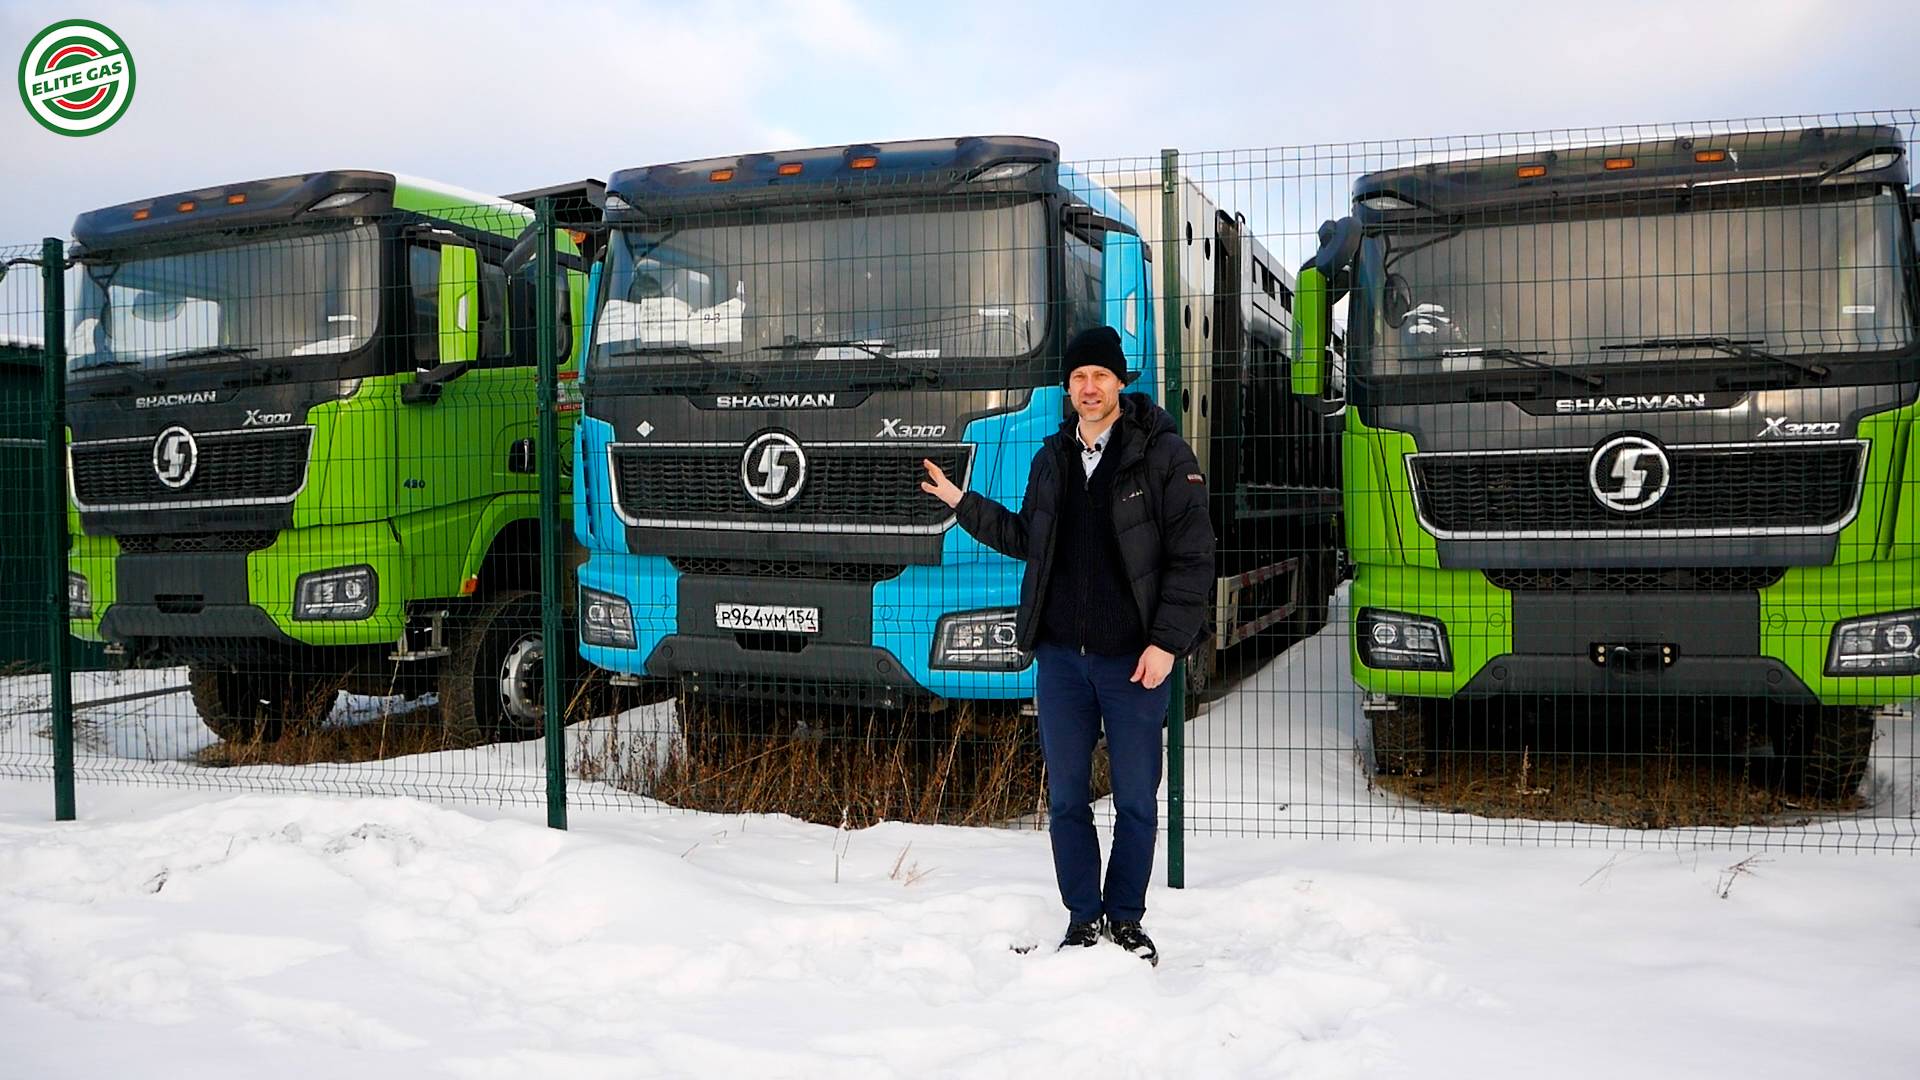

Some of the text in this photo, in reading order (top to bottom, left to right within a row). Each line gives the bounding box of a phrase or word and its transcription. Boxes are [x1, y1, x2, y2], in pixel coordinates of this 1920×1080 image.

[136, 391, 216, 409] SHACMAN
[717, 393, 835, 408] SHACMAN
[1555, 393, 1705, 413] SHACMAN
[242, 409, 292, 426] X3000
[1757, 416, 1840, 437] X3000
[875, 418, 946, 438] X3000
[722, 608, 815, 628] Р964УМ 154
